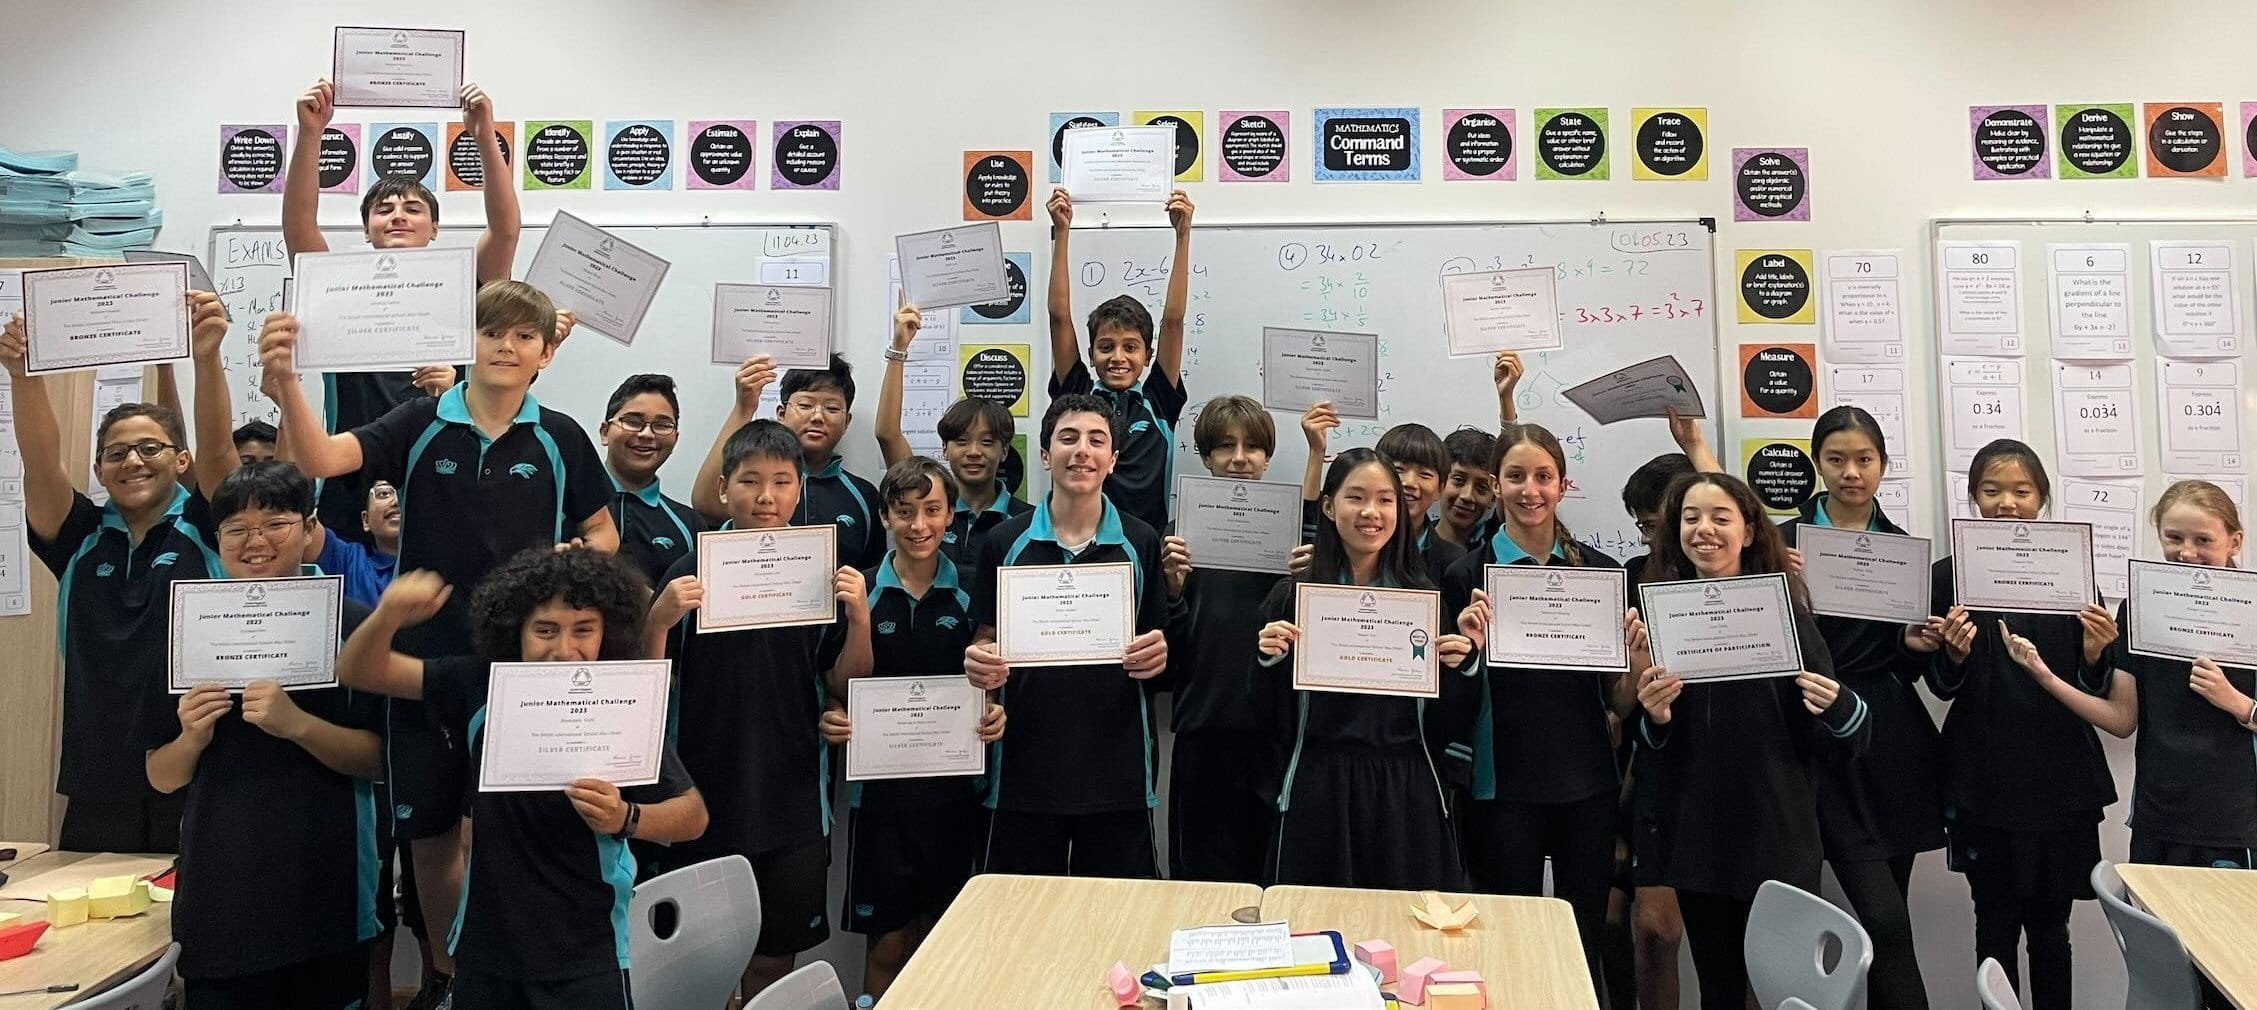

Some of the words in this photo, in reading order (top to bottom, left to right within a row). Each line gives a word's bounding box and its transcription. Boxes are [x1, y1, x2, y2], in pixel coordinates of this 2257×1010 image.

[2082, 113, 2108, 122] Derive
[2171, 112, 2194, 120] Show
[1241, 120, 1266, 129] Sketch
[1462, 117, 1496, 128] Organise
[1560, 118, 1582, 126] State
[1657, 117, 1681, 125] Trace
[1985, 118, 2033, 127] Demonstrate
[545, 128, 570, 138] Identify
[630, 126, 649, 136] Apply
[706, 128, 738, 137] Estimate
[1335, 124, 1399, 133] MATHEMATICS
[391, 131, 415, 140] Justify
[794, 129, 820, 139] Explain
[233, 136, 252, 144] Write
[255, 136, 275, 144] Down
[1331, 135, 1404, 150] Command
[1344, 151, 1390, 166] Terms
[1759, 157, 1780, 166] Solve
[228, 237, 285, 263] EXAMS
[1315, 245, 1335, 264] 34
[1763, 259, 1785, 268] Label
[1972, 254, 1988, 264] 80
[2086, 256, 2094, 267] 6
[2187, 254, 2202, 264] 12
[1624, 260, 1648, 275] 72
[1856, 262, 1871, 273] 70
[786, 269, 798, 279] 11
[980, 353, 1007, 362] Discuss
[1760, 352, 1794, 361] Measure
[2090, 371, 2101, 380] 14
[2197, 368, 2203, 377] 9
[1862, 375, 1874, 383] 17
[1762, 448, 1799, 458] Calculate
[2092, 491, 2109, 503] 72
